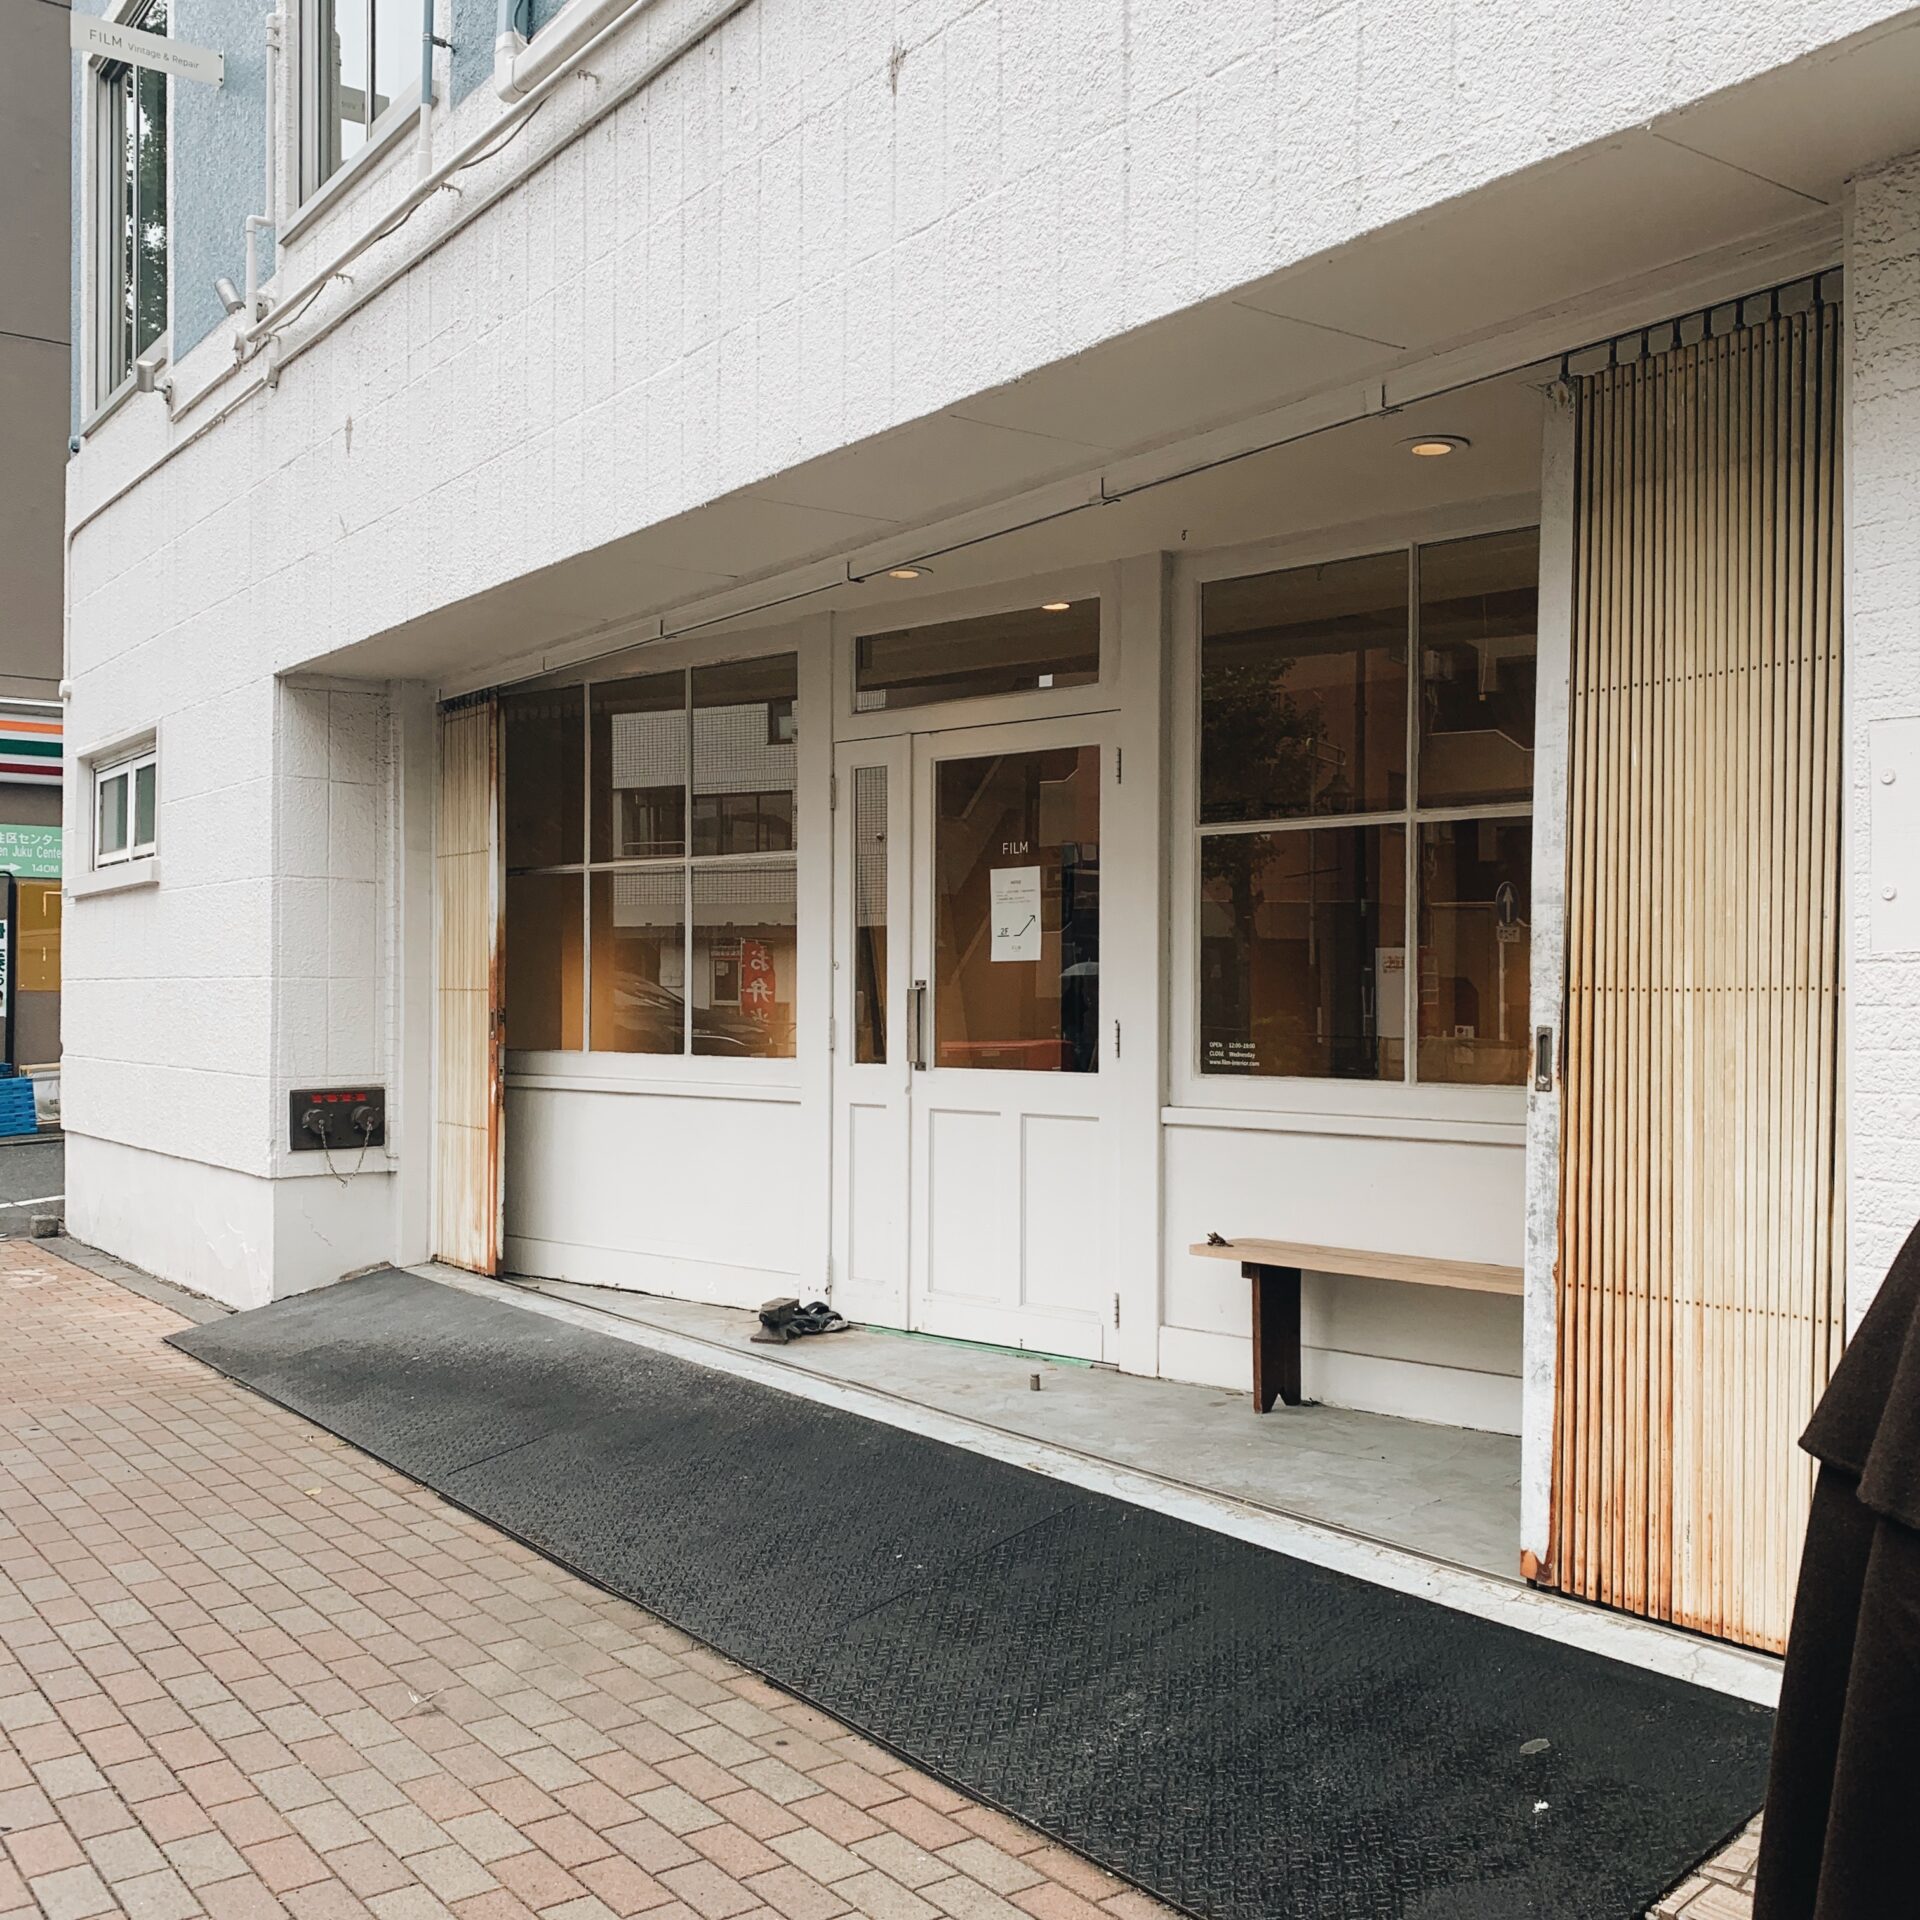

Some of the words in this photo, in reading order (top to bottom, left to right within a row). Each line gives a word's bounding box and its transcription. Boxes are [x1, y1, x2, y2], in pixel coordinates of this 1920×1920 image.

[89, 29, 123, 48] FILM
[128, 43, 161, 61] Vintage
[163, 53, 170, 61] &
[172, 55, 200, 70] Repair
[12, 845, 32, 857] Juku
[1002, 841, 1029, 855] FILM
[31, 863, 59, 873] 140M
